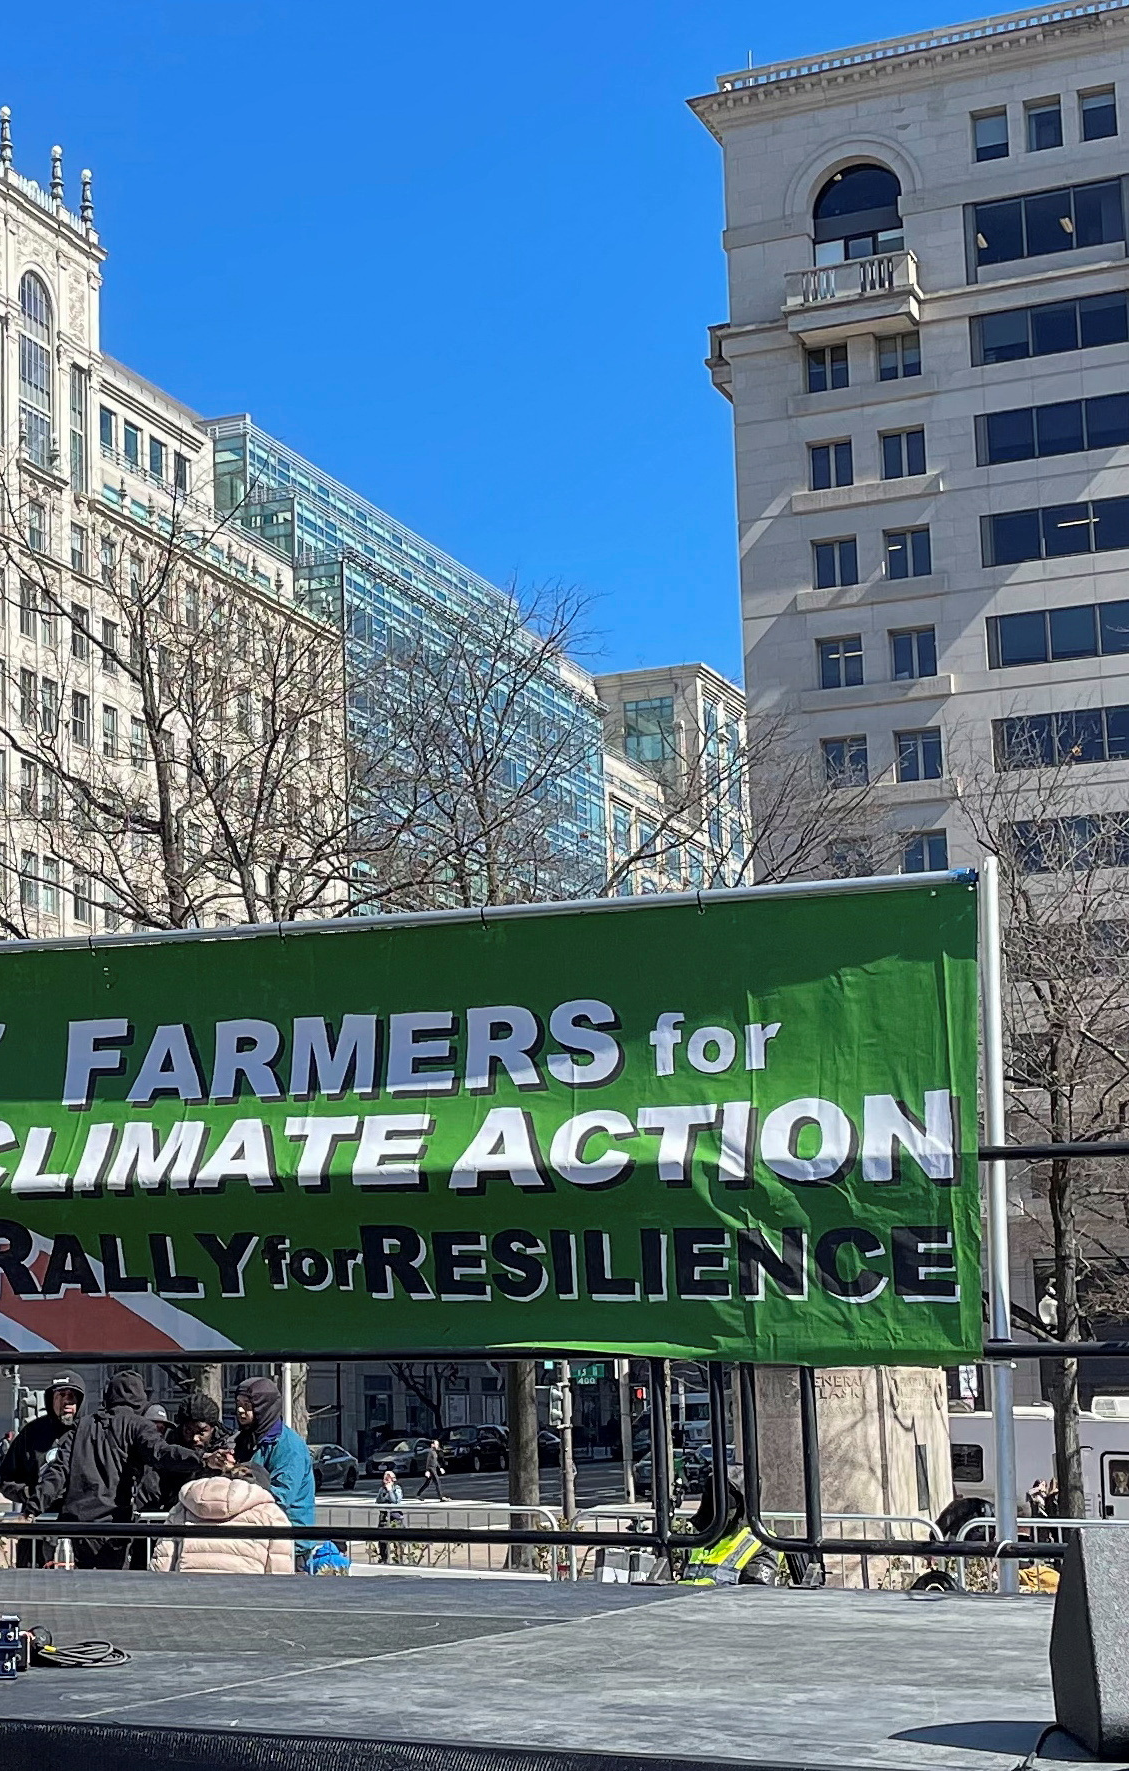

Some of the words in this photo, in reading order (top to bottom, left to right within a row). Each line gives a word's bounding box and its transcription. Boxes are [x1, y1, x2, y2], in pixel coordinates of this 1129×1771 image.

[60, 999, 623, 1112] FARMERS
[649, 1012, 782, 1077] for
[448, 1088, 960, 1196] ACTION
[261, 1234, 363, 1291] for
[359, 1225, 961, 1304] RESILIENCE
[578, 1377, 596, 1385] 400
[814, 1375, 864, 1388] ENERAL
